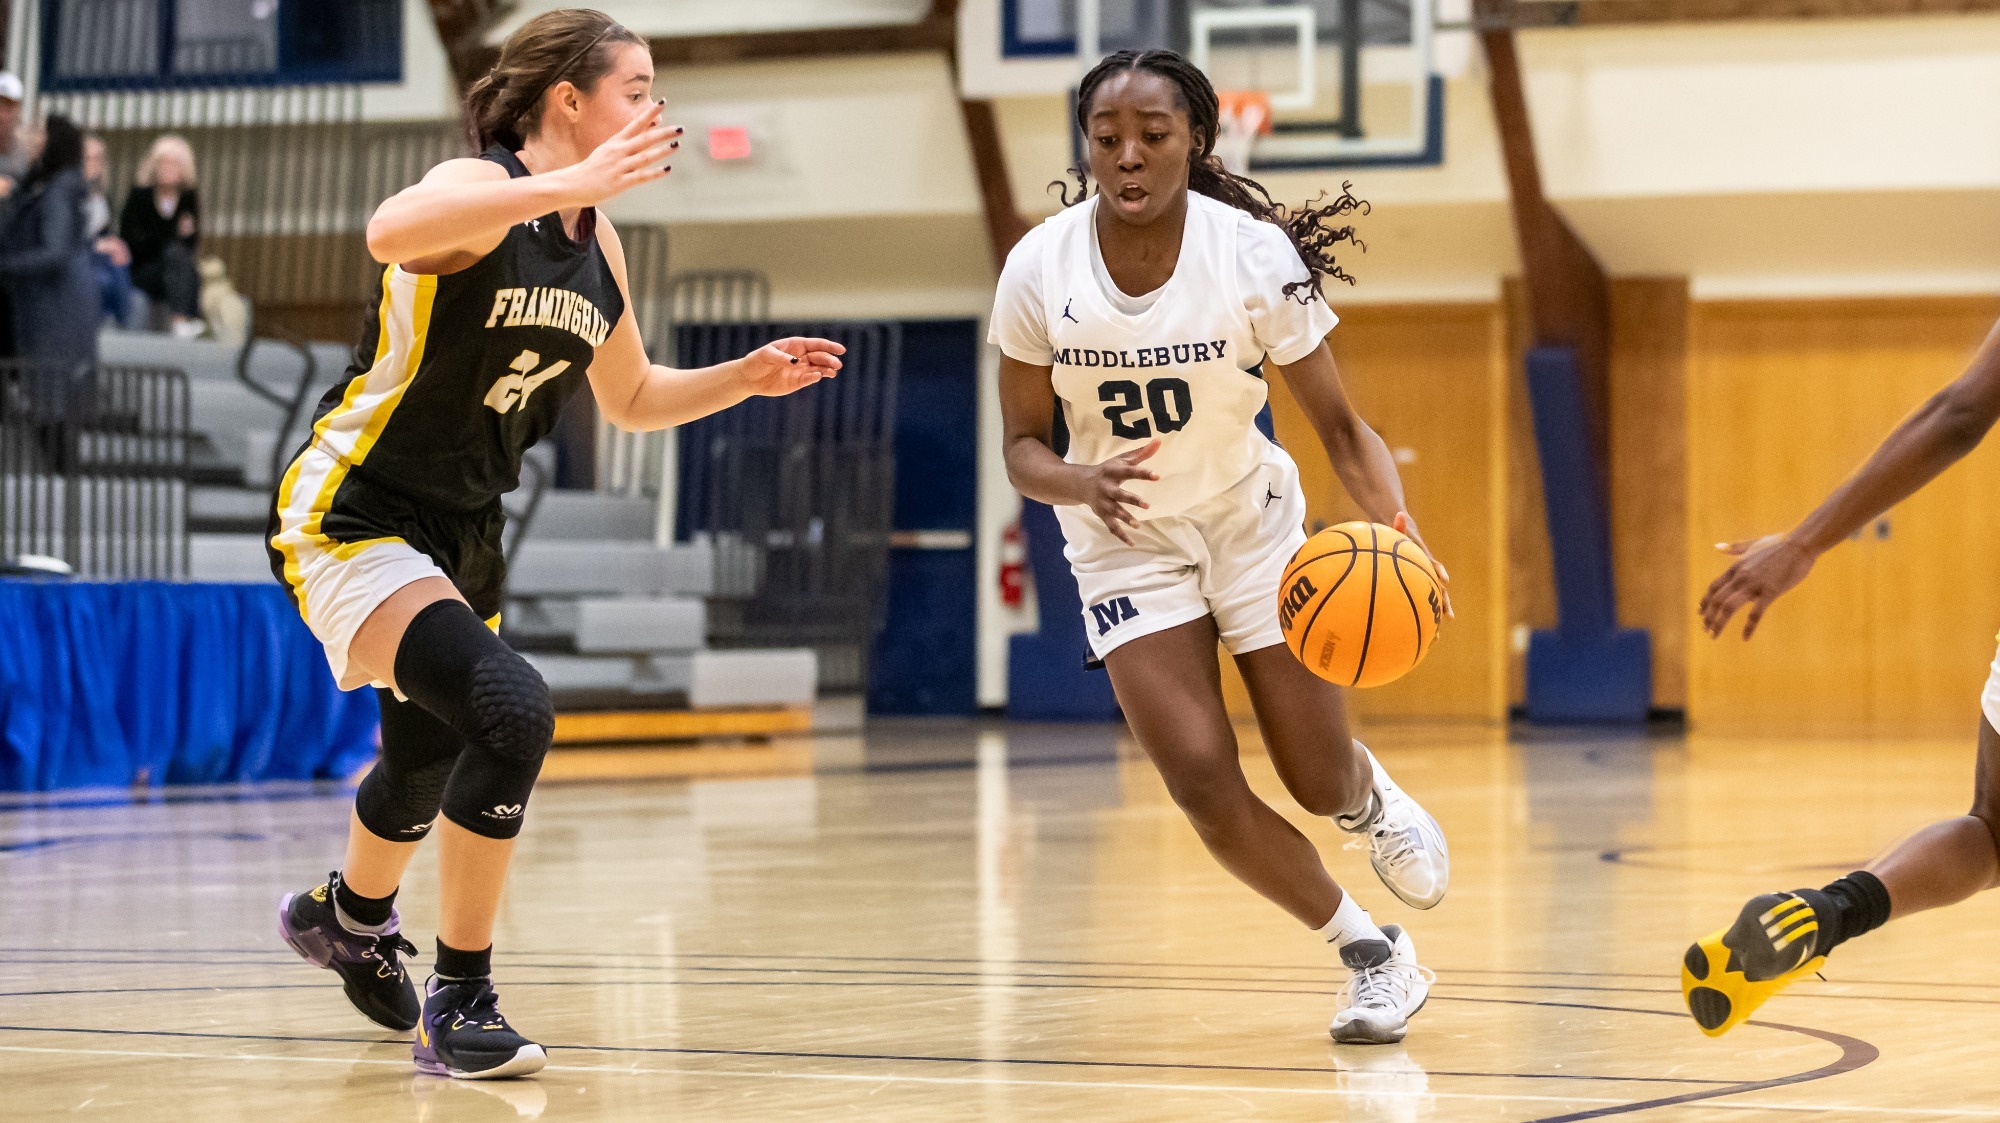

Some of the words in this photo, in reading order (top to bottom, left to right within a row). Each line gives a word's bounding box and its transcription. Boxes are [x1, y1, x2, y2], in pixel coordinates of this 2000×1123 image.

[1054, 340, 1227, 368] MIDDLEBURY
[1098, 378, 1193, 440] 20
[1089, 596, 1139, 636] M
